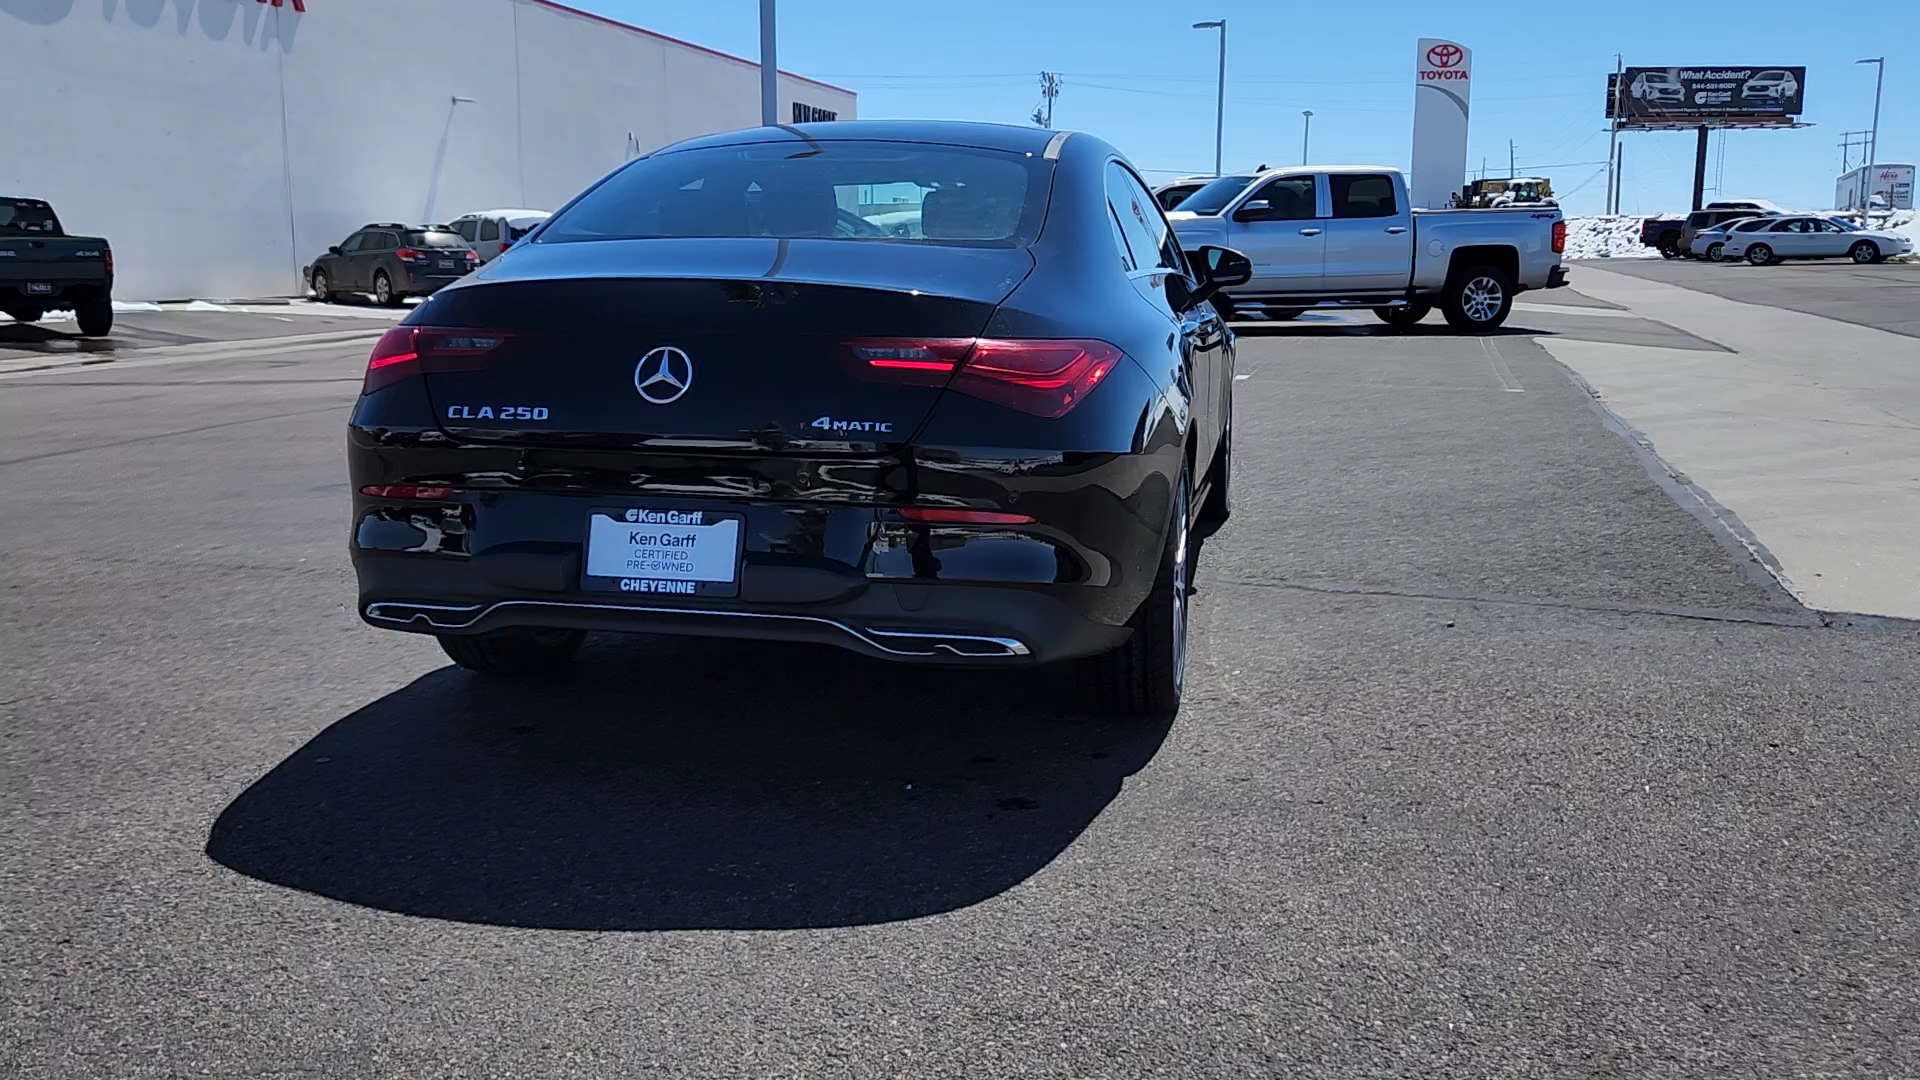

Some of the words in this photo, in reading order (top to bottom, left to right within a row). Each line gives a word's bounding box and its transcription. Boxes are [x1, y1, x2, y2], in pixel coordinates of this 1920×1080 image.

[1419, 70, 1468, 80] TOYOTA
[1680, 70, 1704, 80] What
[1704, 69, 1751, 80] Accident?
[448, 405, 494, 419] CLA
[500, 406, 549, 420] 250
[811, 416, 893, 432] 4MATIC
[638, 509, 666, 523] Ken
[667, 510, 703, 525] Garff
[629, 531, 657, 546] Ken
[660, 532, 697, 548] Garff
[634, 549, 688, 561] CERTIFIED
[626, 560, 694, 572] PRE-OWNED
[620, 579, 696, 594] CHEYENNE
